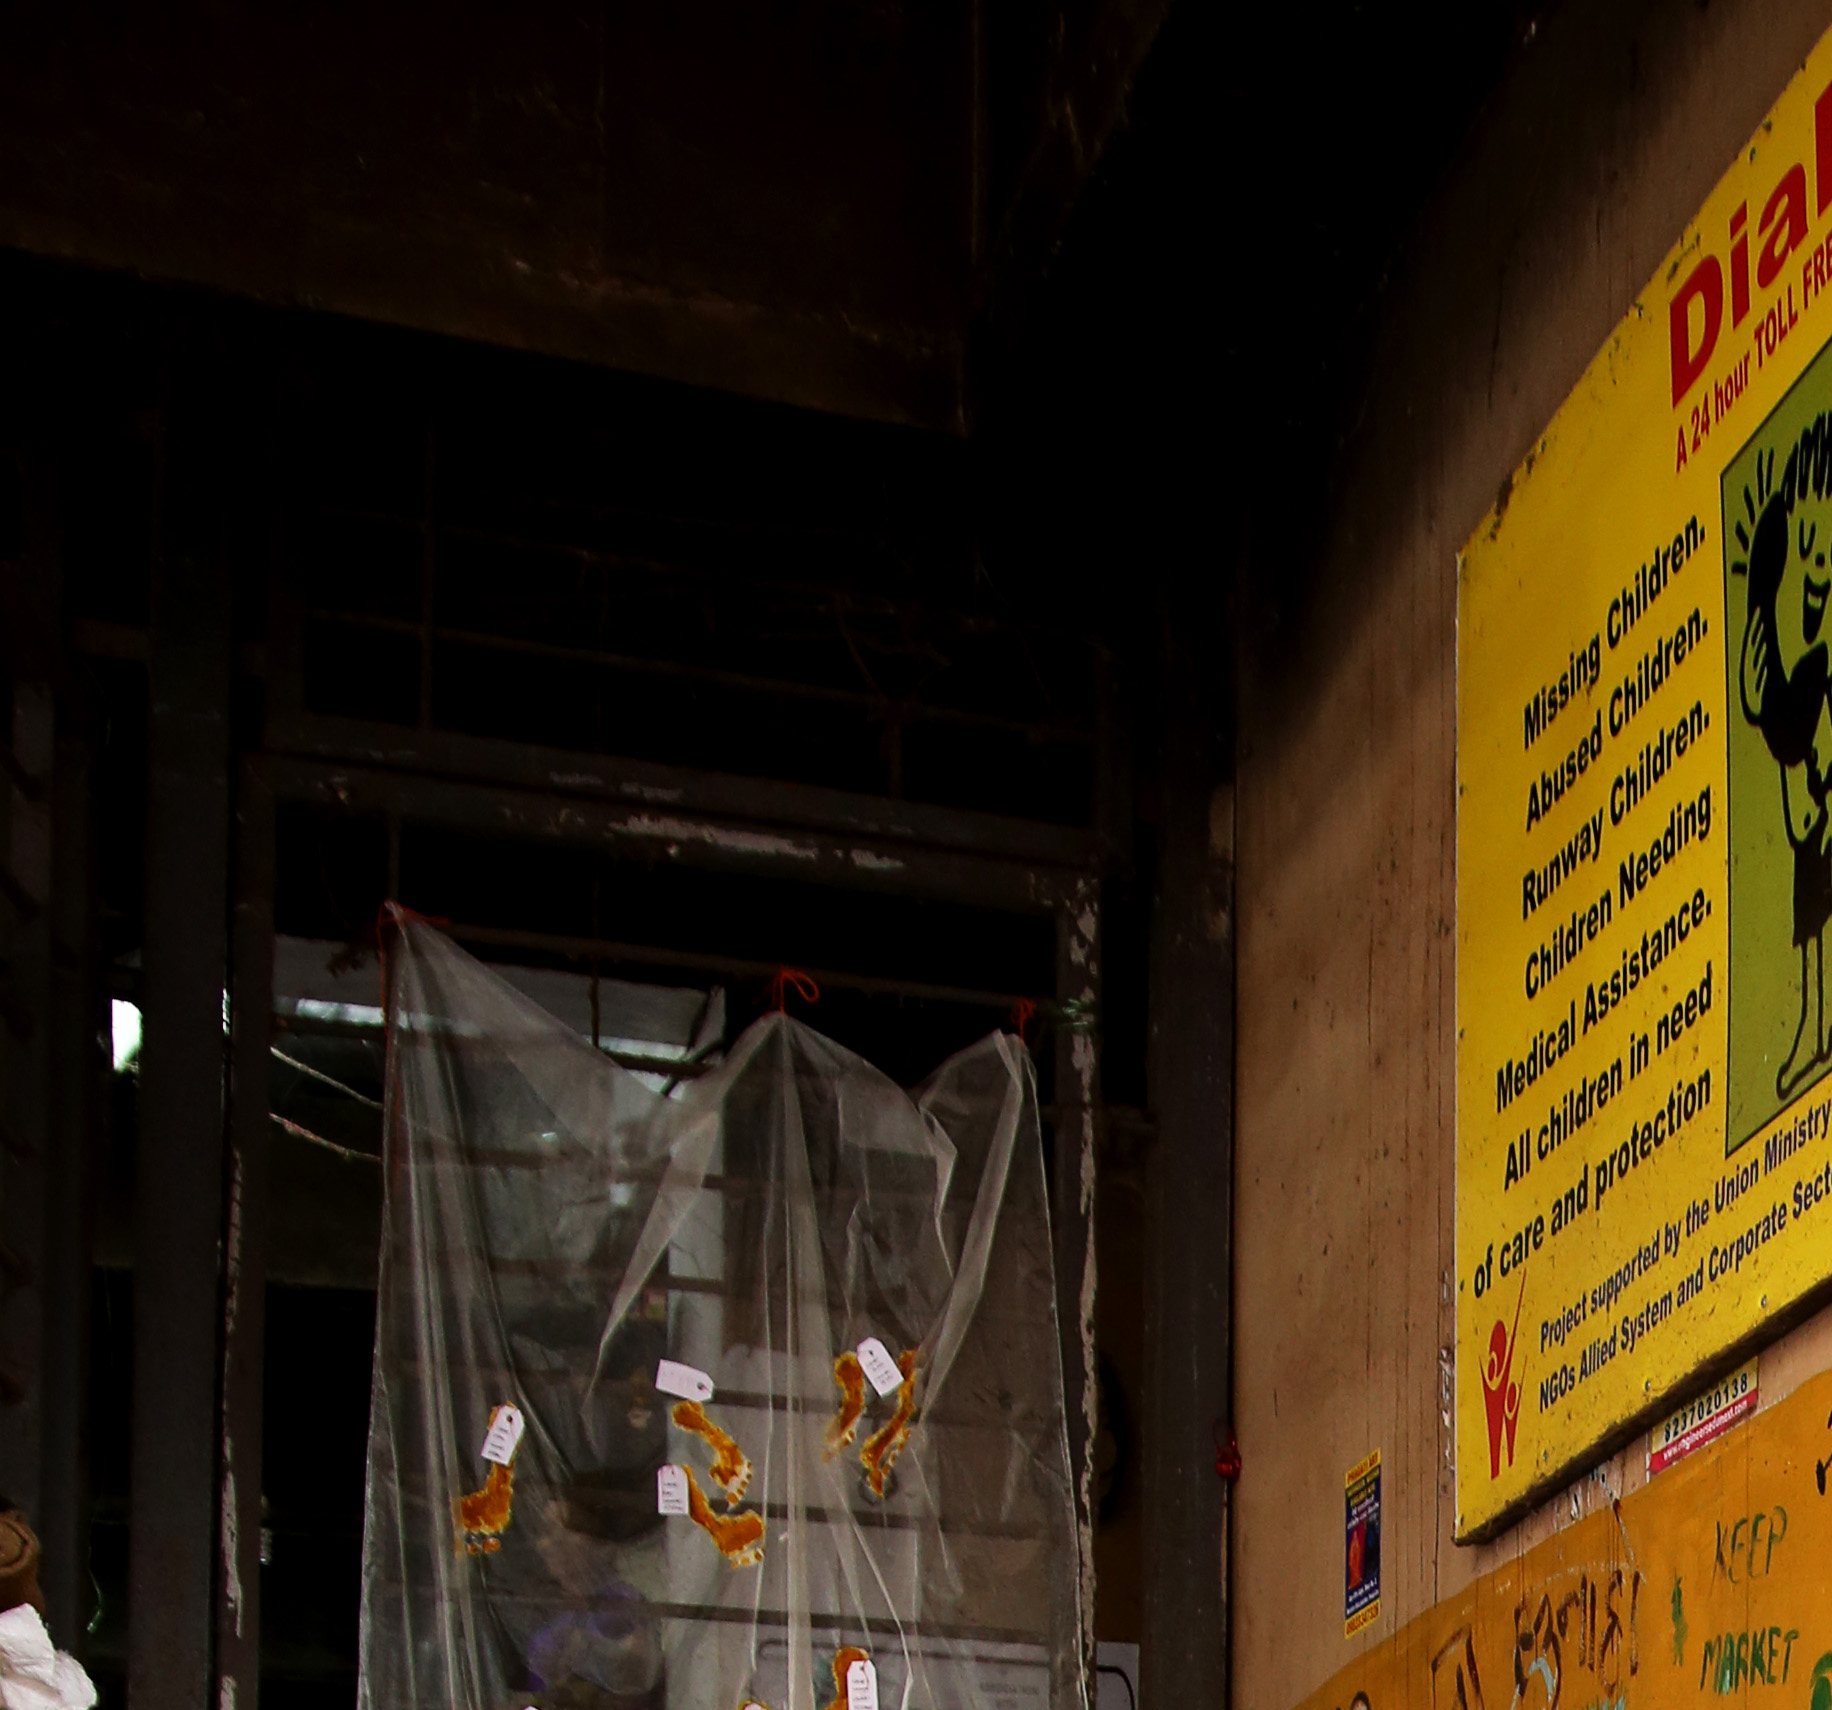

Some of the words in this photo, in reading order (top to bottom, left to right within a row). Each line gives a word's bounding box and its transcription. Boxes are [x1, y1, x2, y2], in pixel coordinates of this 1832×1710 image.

[1676, 425, 1687, 474] A
[1690, 404, 1710, 454] 24
[1714, 349, 1750, 430] hour
[1754, 285, 1799, 370] TOLL
[1523, 631, 1601, 750] Missing
[1606, 514, 1706, 652] Children.
[1526, 708, 1601, 833] Abused
[1608, 606, 1709, 739] Children.
[1522, 805, 1604, 921] Runway
[1610, 699, 1711, 829] Children.
[1525, 887, 1612, 1001] Children
[1618, 784, 1712, 910] Needing
[1496, 1000, 1576, 1115] Medical
[1582, 885, 1712, 1036] Assistance.
[1504, 1128, 1530, 1192] All
[1537, 1057, 1623, 1162] children
[1629, 1033, 1650, 1080] in
[1656, 960, 1714, 1057] need
[1473, 1243, 1495, 1300] of
[1499, 1212, 1545, 1278] care
[1550, 1162, 1589, 1237] and
[1594, 1067, 1712, 1212] protection
[1539, 1296, 1587, 1354] Project
[1590, 1229, 1661, 1313] supported
[1664, 1222, 1682, 1258] by
[1685, 1197, 1710, 1239] the
[1714, 1159, 1769, 1213] Union
[1764, 1101, 1831, 1176] Ministry
[1539, 1364, 1575, 1415] NGOs
[1579, 1324, 1617, 1384] Allied
[1620, 1294, 1673, 1352] System
[1676, 1261, 1703, 1309] and
[1708, 1207, 1787, 1283] Corporate
[1664, 1373, 1748, 1442] 8237020138
[1713, 1505, 1787, 1594] KEEP
[1700, 1626, 1800, 1696] MARKET
